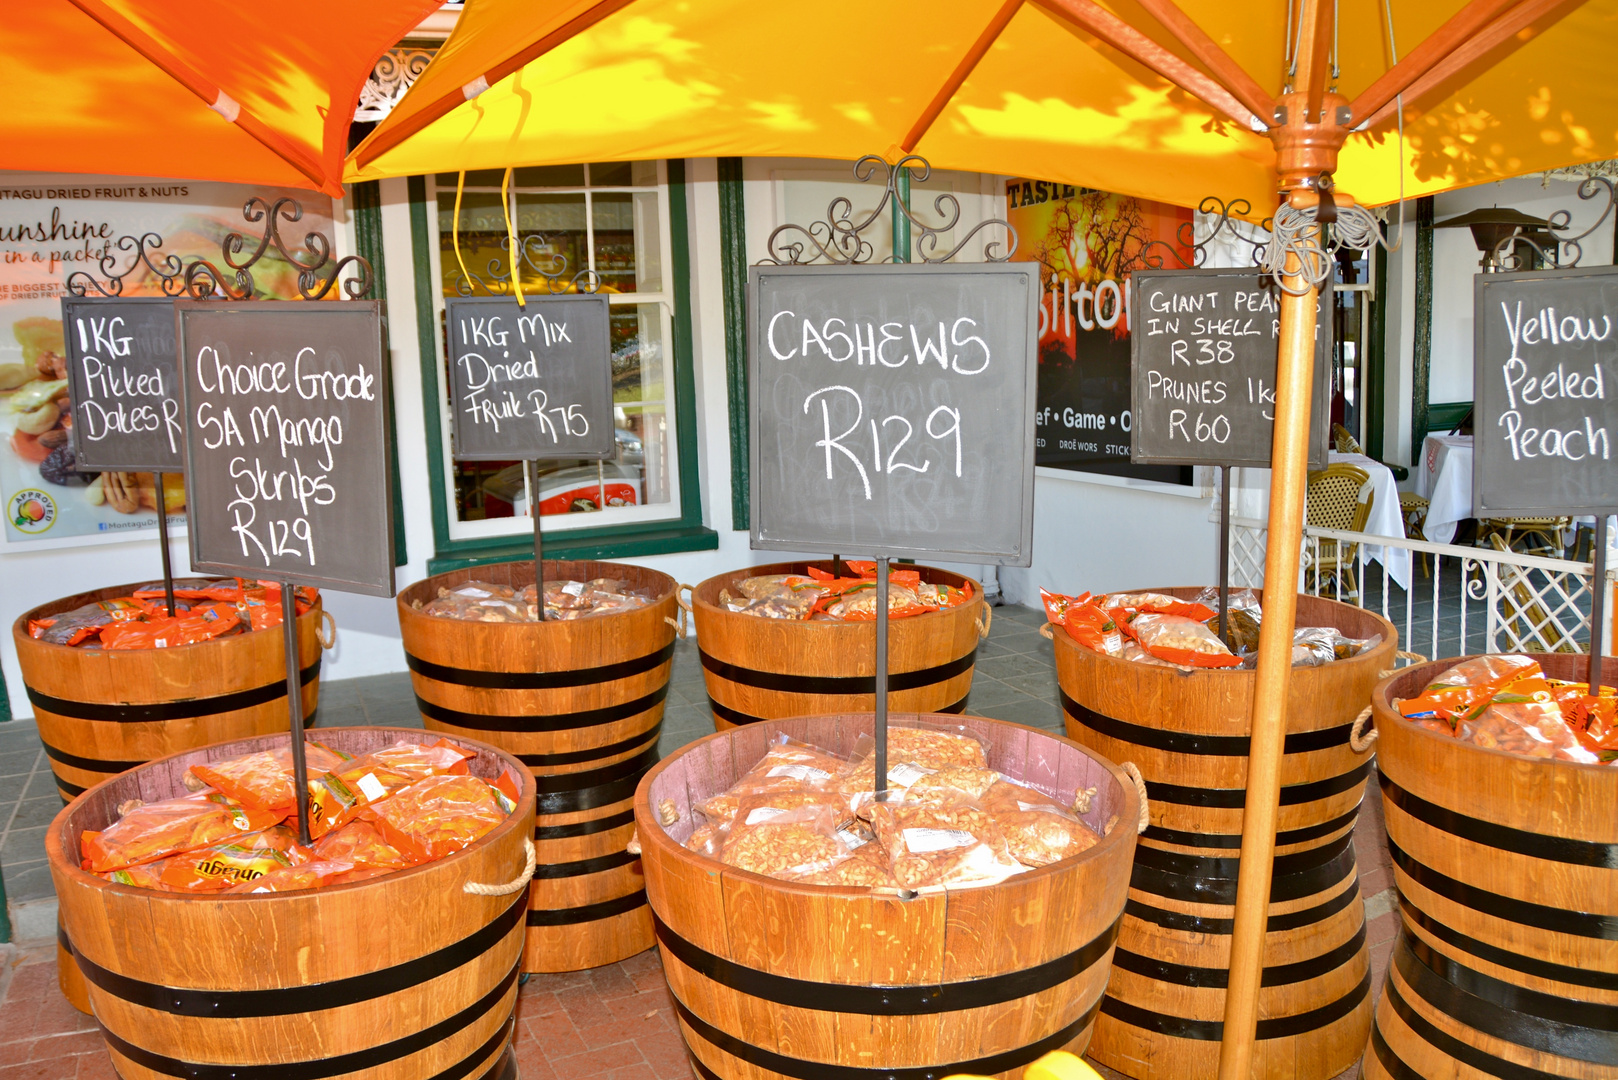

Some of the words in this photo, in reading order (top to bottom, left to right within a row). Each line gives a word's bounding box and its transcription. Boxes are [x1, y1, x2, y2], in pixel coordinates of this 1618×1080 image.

[47, 188, 91, 199] DRIED
[95, 187, 136, 198] FRUIT
[139, 187, 148, 197] &
[152, 186, 189, 197] NUTS
[5, 250, 26, 263] in
[31, 251, 46, 263] a
[11, 292, 39, 300] DRIED
[41, 290, 67, 299] FRUIT
[12, 282, 60, 293] BIGGEST
[1149, 291, 1219, 313] GIANT
[77, 316, 133, 360] 1KG
[461, 316, 509, 348] 1KG
[767, 310, 991, 376] CASHEWS
[1147, 318, 1180, 336] IN
[1190, 317, 1261, 337] SHELL
[197, 345, 291, 395] Choice
[457, 350, 541, 389] Dried
[1147, 370, 1227, 404] PRUNES
[1503, 357, 1604, 409] Peeled
[526, 389, 589, 443] R75
[1063, 407, 1106, 431] Game
[1169, 408, 1231, 444] R60
[197, 402, 246, 449] SA
[250, 404, 343, 471] Mango
[803, 384, 963, 500] R129
[1078, 442, 1098, 453] WORS
[1498, 410, 1610, 461] Peach
[15, 491, 54, 522] APPROVED
[227, 499, 316, 567] R129
